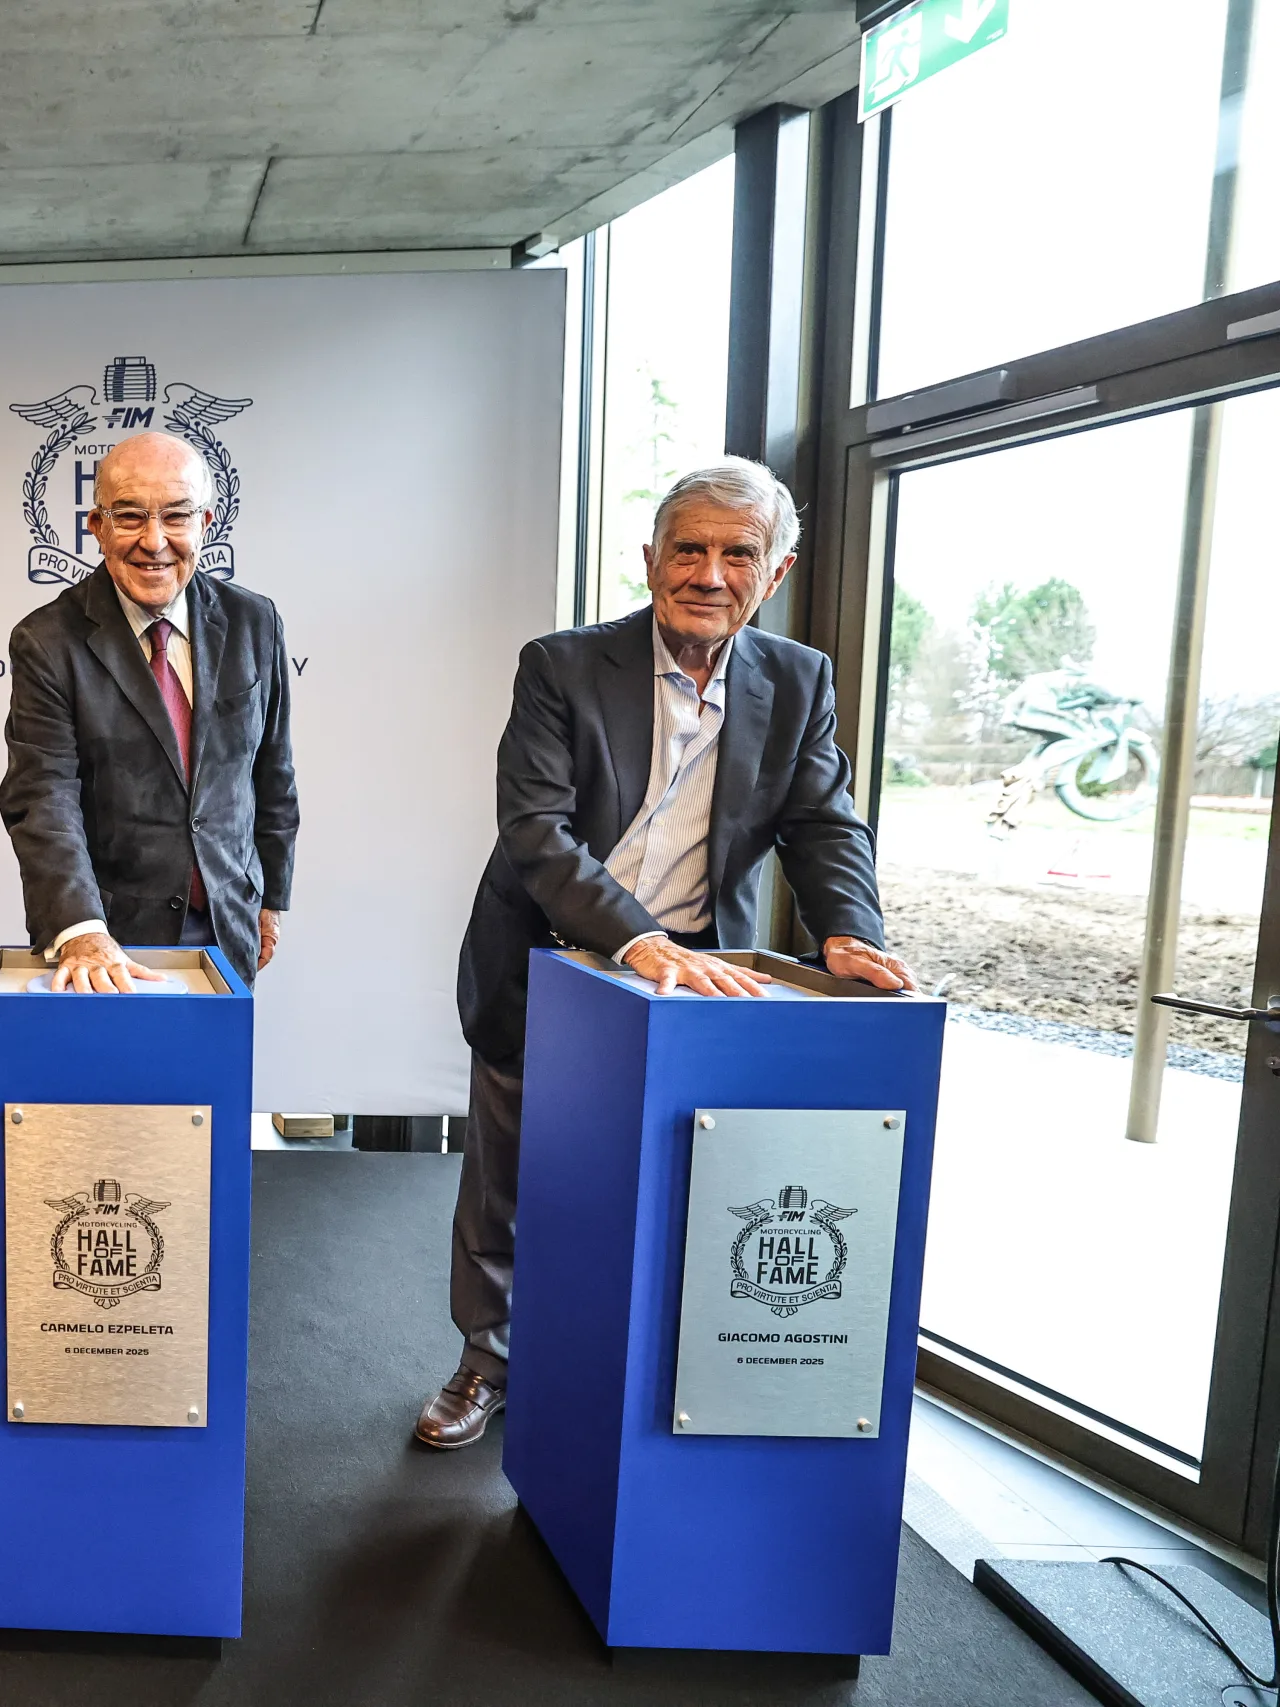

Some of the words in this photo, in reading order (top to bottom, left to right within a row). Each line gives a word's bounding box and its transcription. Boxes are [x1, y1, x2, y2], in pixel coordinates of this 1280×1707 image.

[102, 406, 155, 428] FIM
[38, 552, 68, 572] PRO
[93, 1204, 120, 1215] FIM
[777, 1211, 805, 1222] FIM
[78, 1229, 136, 1252] HALL
[759, 1236, 819, 1260] HALL
[94, 1247, 122, 1258] OF
[78, 1254, 136, 1277] FAME
[774, 1256, 804, 1266] OF
[757, 1261, 818, 1285] FAME
[58, 1273, 74, 1284] PRO
[76, 1281, 108, 1295] VIRTUTE
[111, 1287, 120, 1295] ET
[123, 1275, 158, 1293] SCIENTIA
[736, 1282, 753, 1292] PRO
[753, 1289, 786, 1303] VIRTUTE
[789, 1295, 799, 1303] ET
[802, 1283, 838, 1301] SCIENTIA
[40, 1323, 104, 1333] CARMELO
[108, 1324, 174, 1335] EZPELETA
[718, 1333, 780, 1343] GIACOMO
[784, 1333, 848, 1344] AGOSTINI
[73, 1347, 123, 1355] DECEMBER
[745, 1357, 797, 1365] DECEMBER
